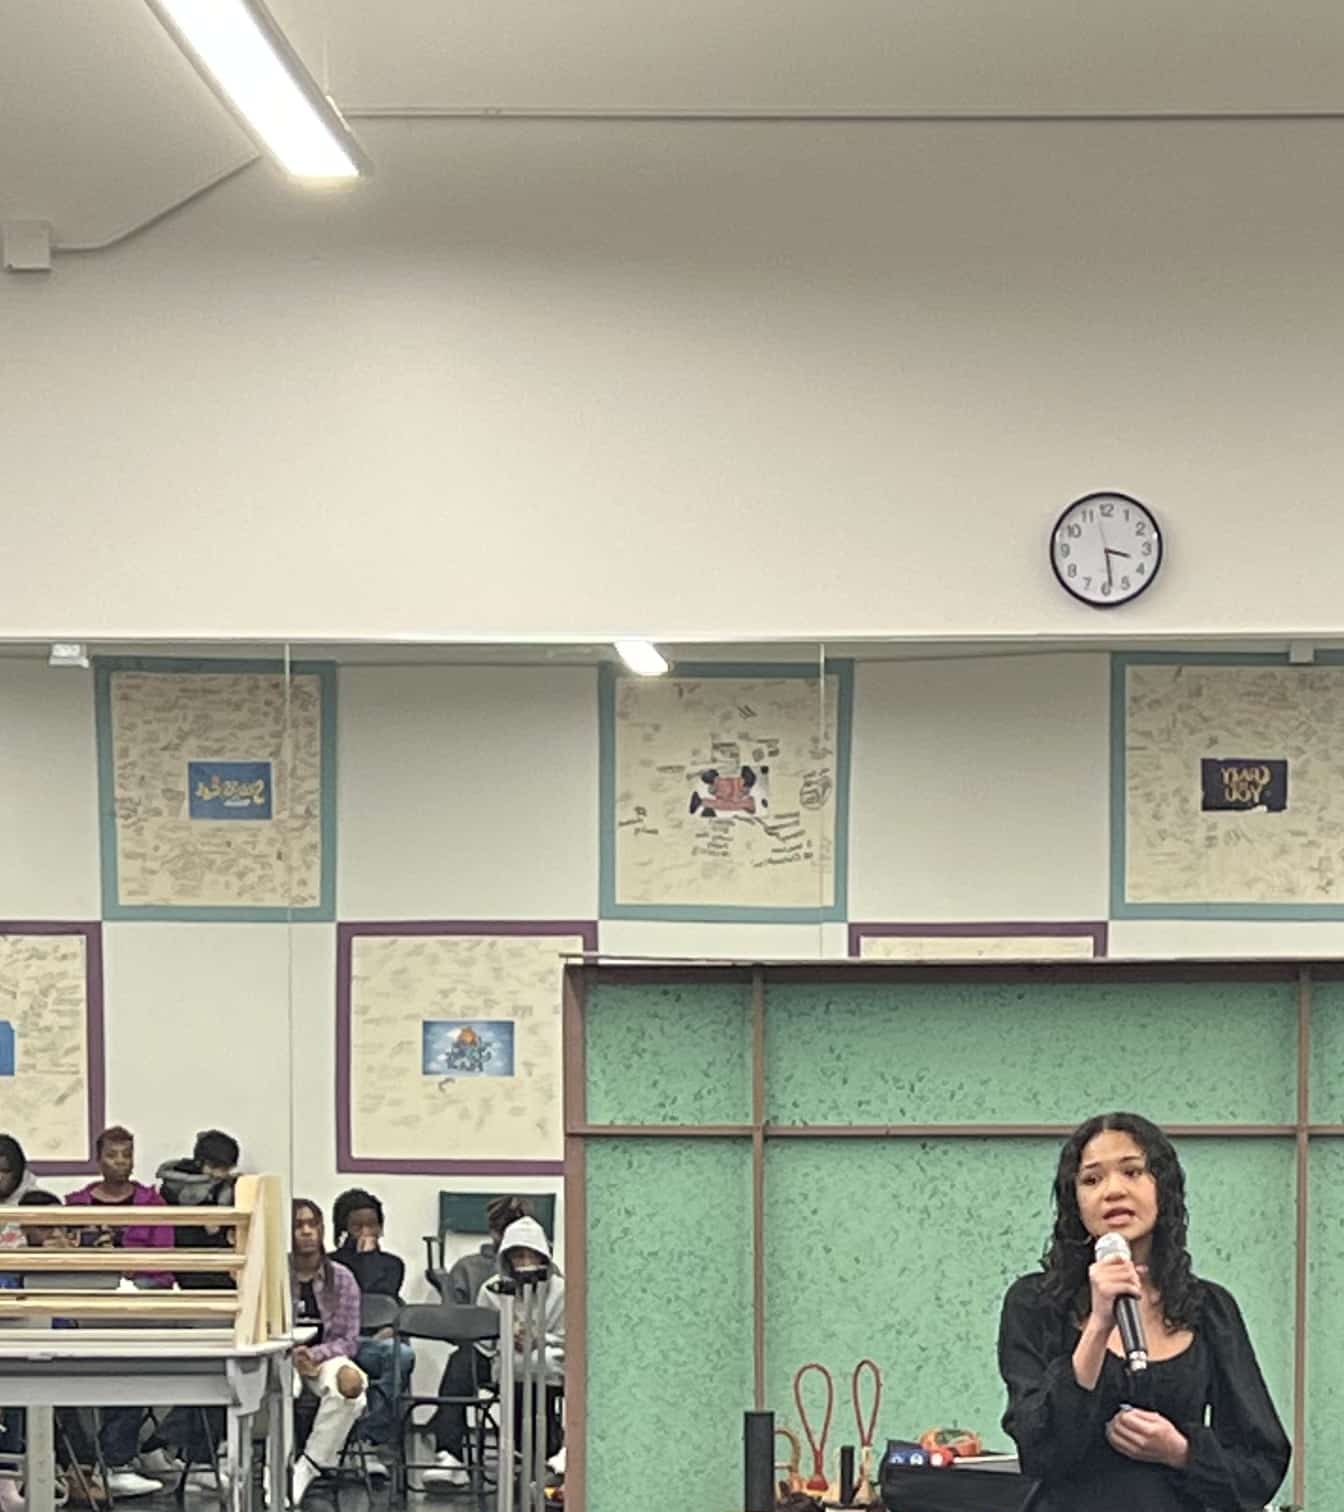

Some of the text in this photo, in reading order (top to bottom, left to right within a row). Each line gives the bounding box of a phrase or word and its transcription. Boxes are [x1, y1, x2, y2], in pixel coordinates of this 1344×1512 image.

[1081, 509, 1094, 522] 11
[1099, 503, 1114, 517] 12
[1123, 509, 1130, 522] 1
[1067, 523, 1082, 538] 10
[1135, 521, 1146, 536] 2
[1060, 543, 1070, 558] 9
[1141, 542, 1152, 556] 3
[1067, 563, 1077, 578] 8
[1136, 562, 1145, 576] 4
[1082, 576, 1092, 591] 7
[1121, 576, 1131, 591] 5
